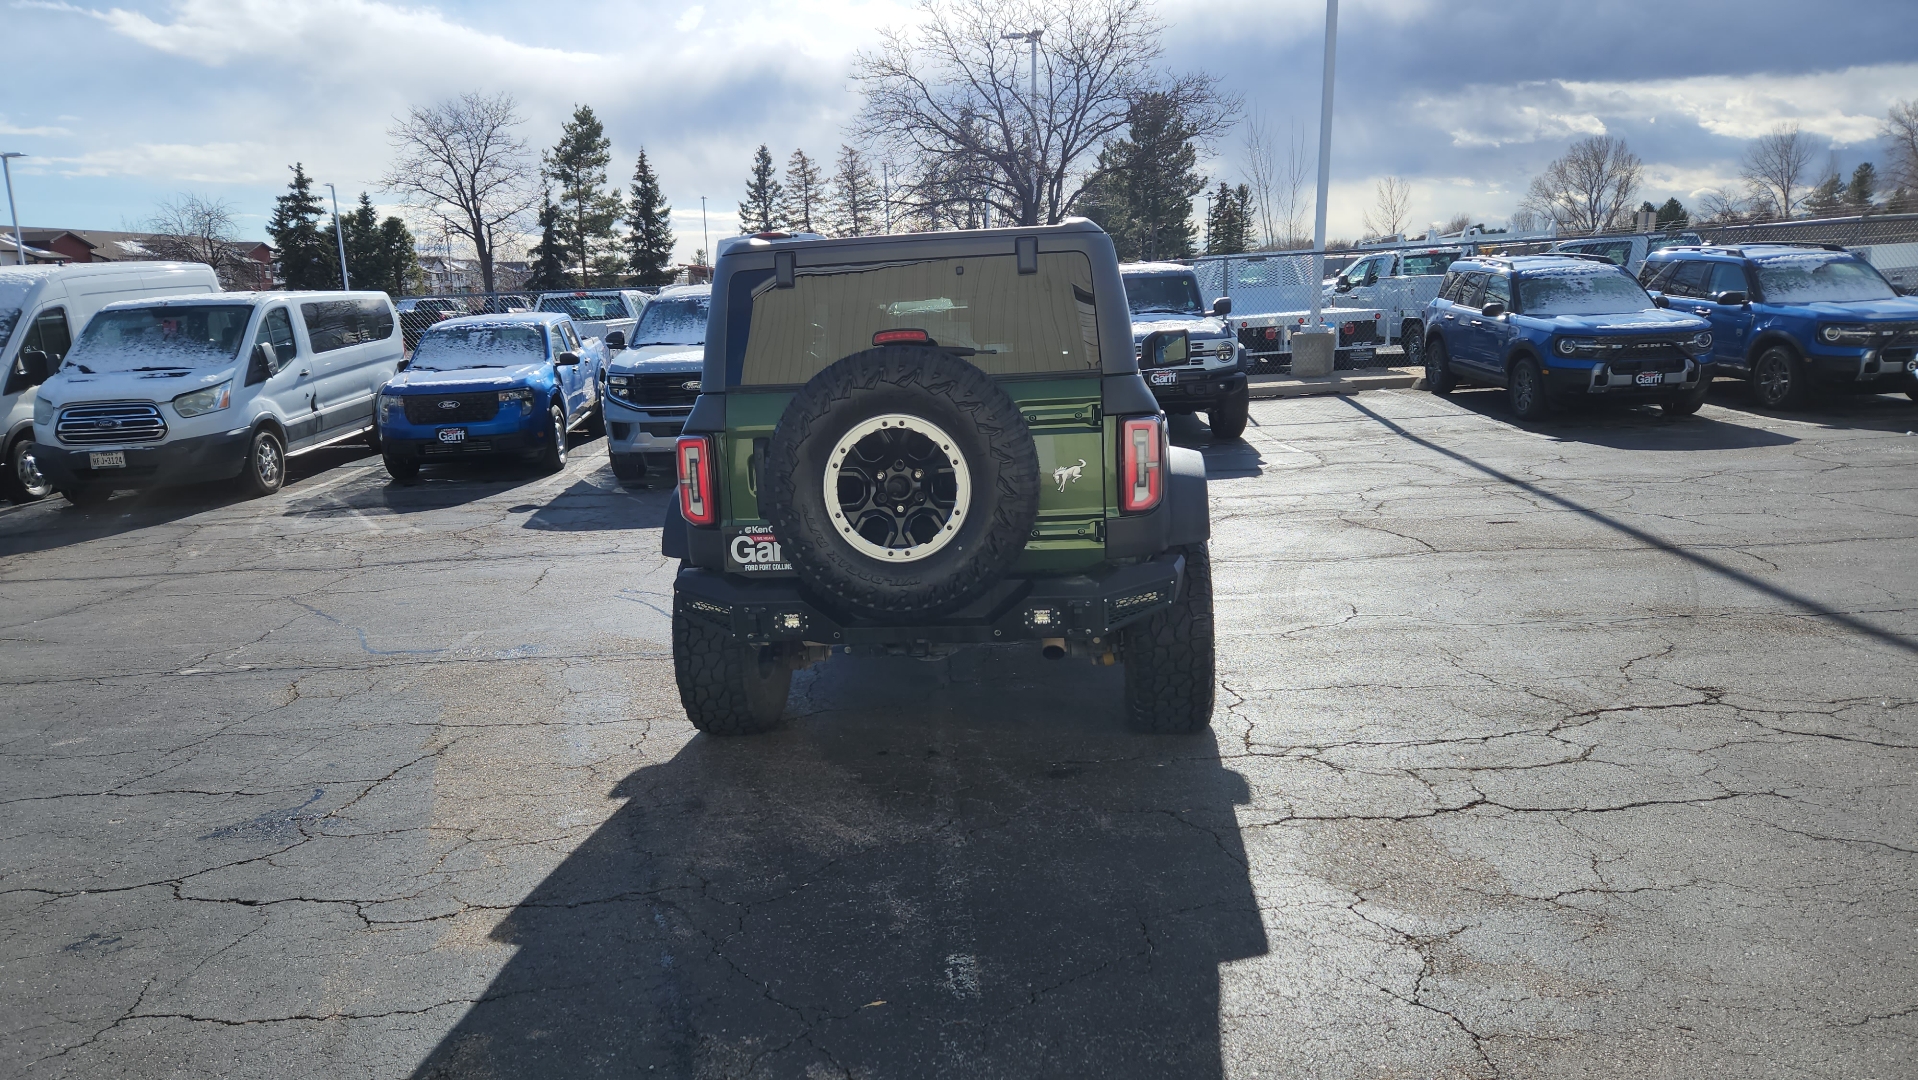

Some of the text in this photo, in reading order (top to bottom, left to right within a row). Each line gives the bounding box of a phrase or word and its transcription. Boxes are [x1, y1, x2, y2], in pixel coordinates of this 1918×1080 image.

[1150, 372, 1177, 384] Garff
[1635, 373, 1663, 385] Garff
[438, 430, 465, 441] Garff
[752, 525, 768, 534] Ken
[744, 564, 759, 572] FORD
[759, 563, 772, 571] FORT
